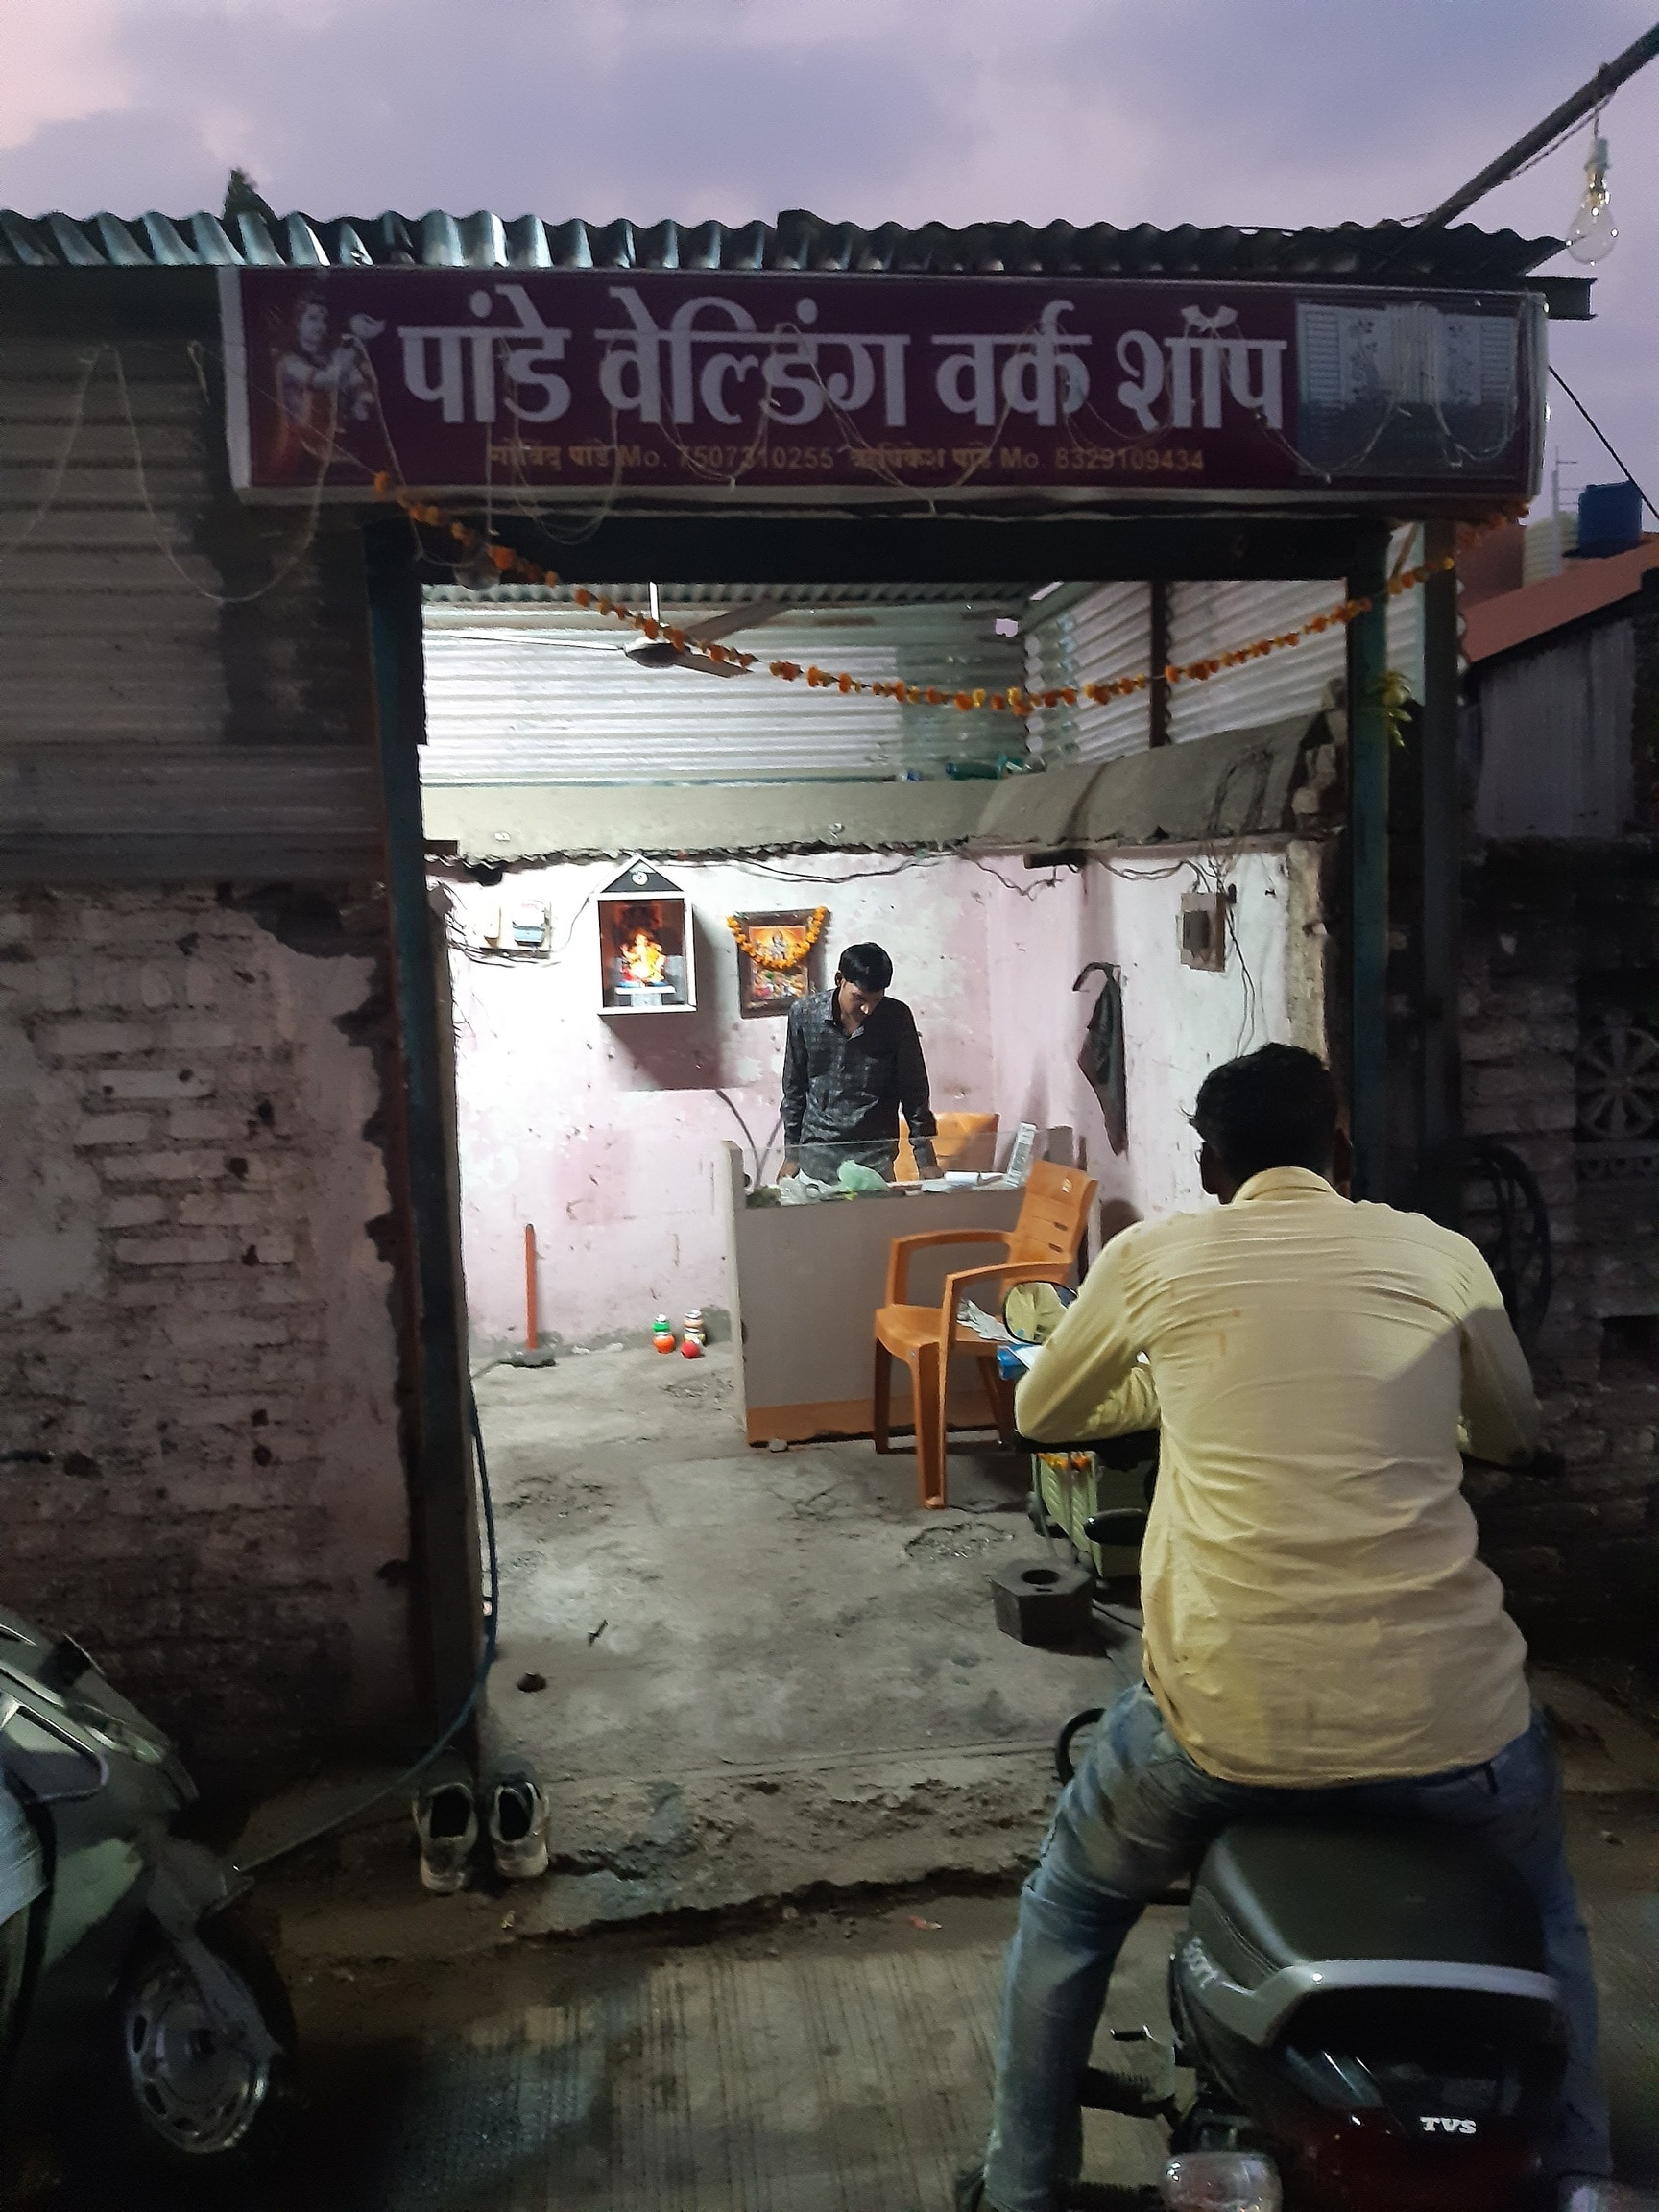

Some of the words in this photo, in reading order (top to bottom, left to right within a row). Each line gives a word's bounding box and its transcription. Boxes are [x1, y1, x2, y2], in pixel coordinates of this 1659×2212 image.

[398, 285, 572, 424] पांडे
[594, 286, 910, 426] वेल्डिंग
[931, 301, 1092, 426] वर्क
[1117, 305, 1287, 431] शॉप
[1420, 2116, 1477, 2134] TVS
